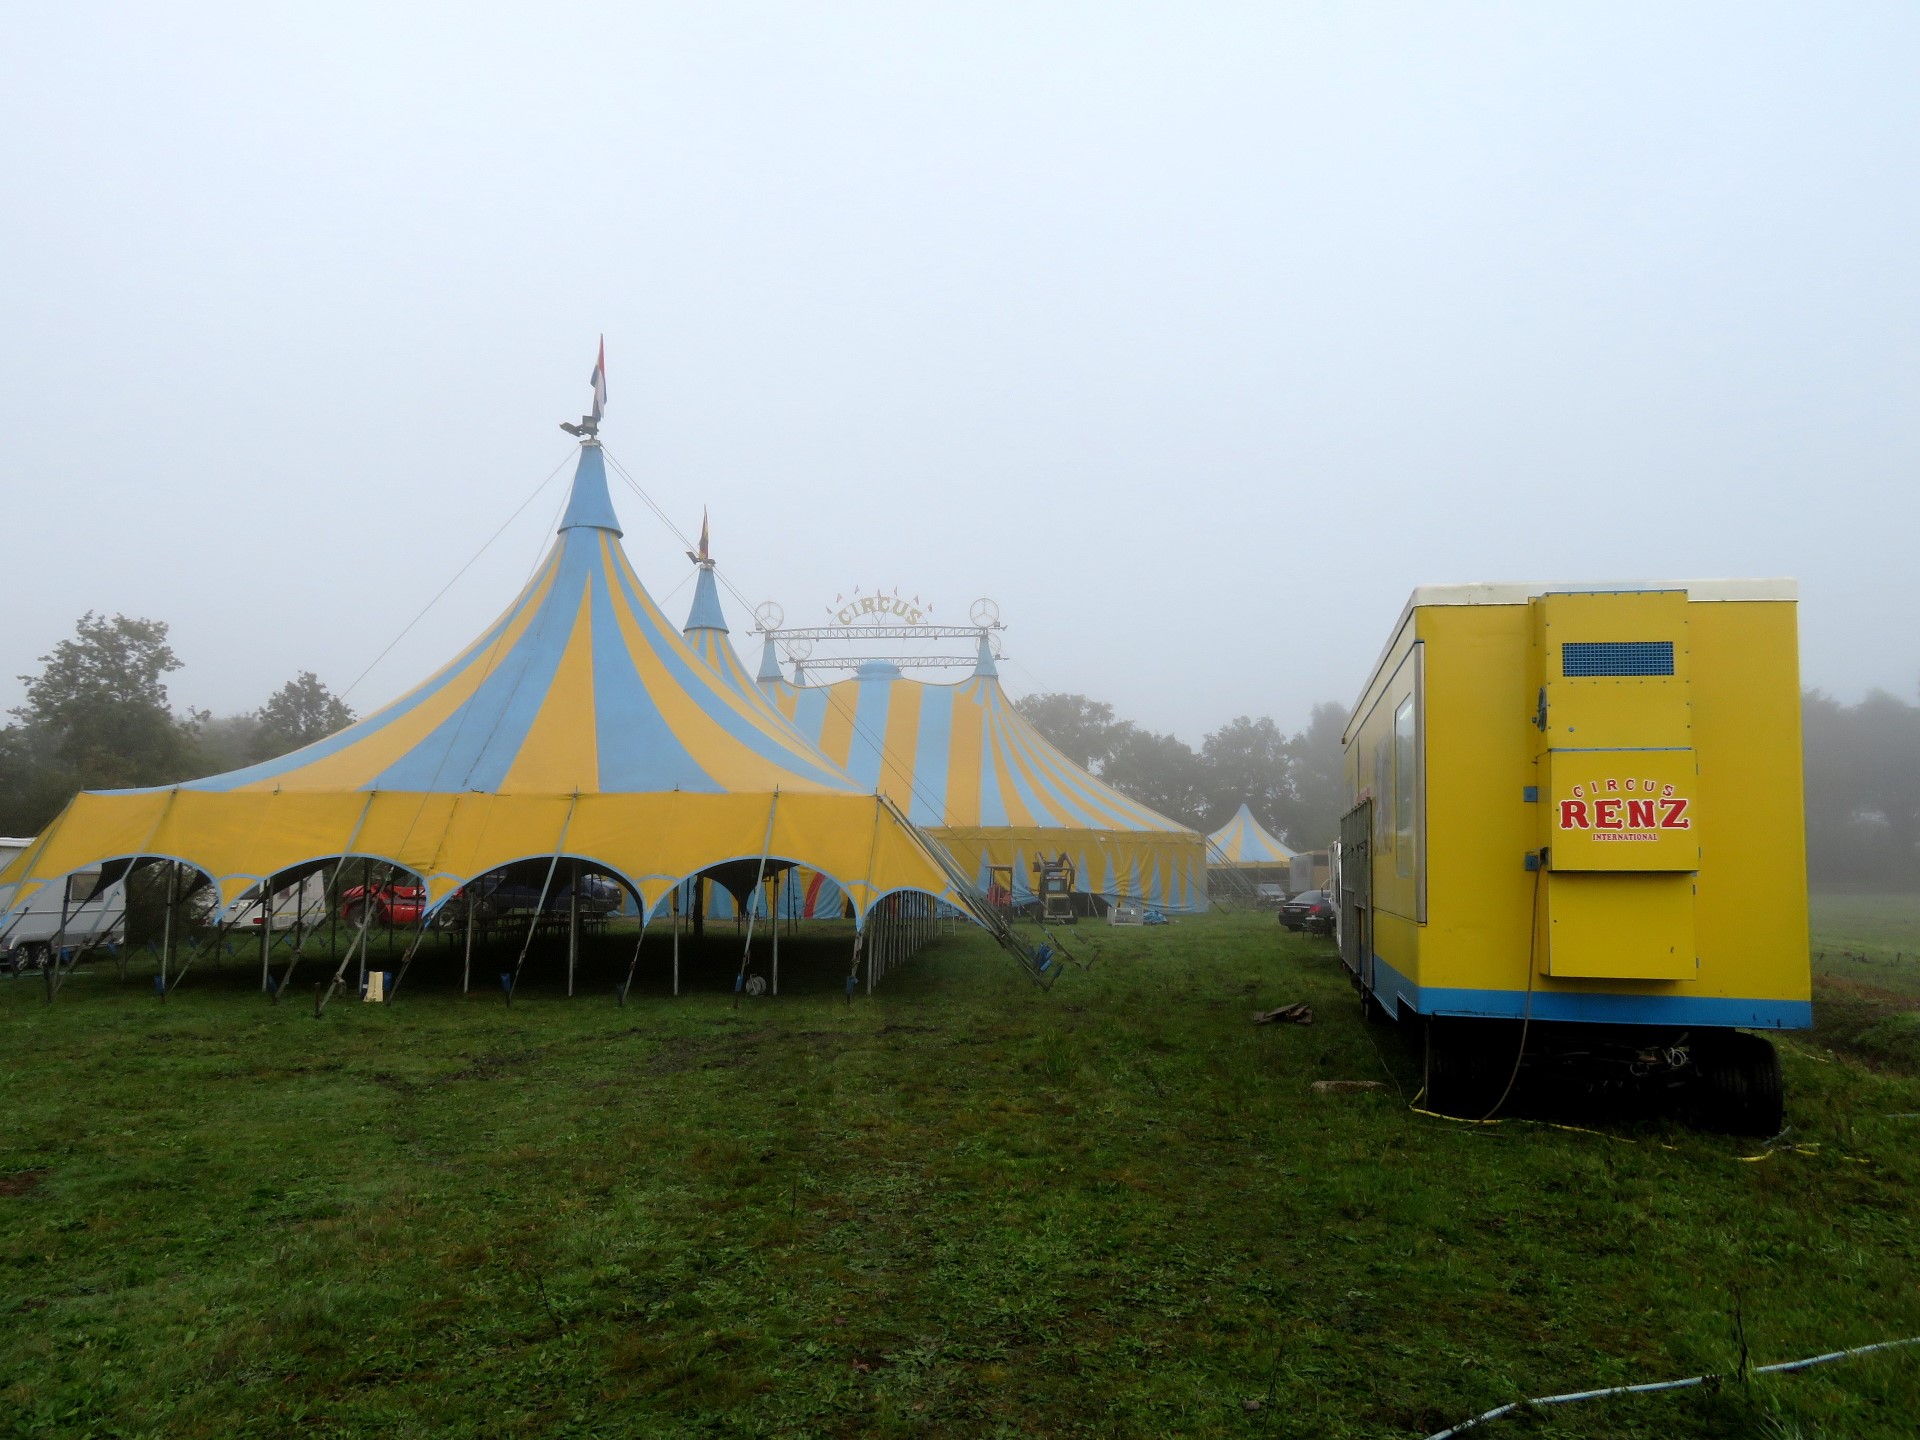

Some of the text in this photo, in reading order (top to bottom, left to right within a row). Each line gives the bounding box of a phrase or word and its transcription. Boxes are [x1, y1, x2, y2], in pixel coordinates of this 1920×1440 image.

[838, 597, 922, 625] CIRCUS
[1573, 779, 1674, 798] CIRCUS
[1560, 799, 1690, 830] RENZ
[1592, 833, 1658, 841] INTERNATIONAL
